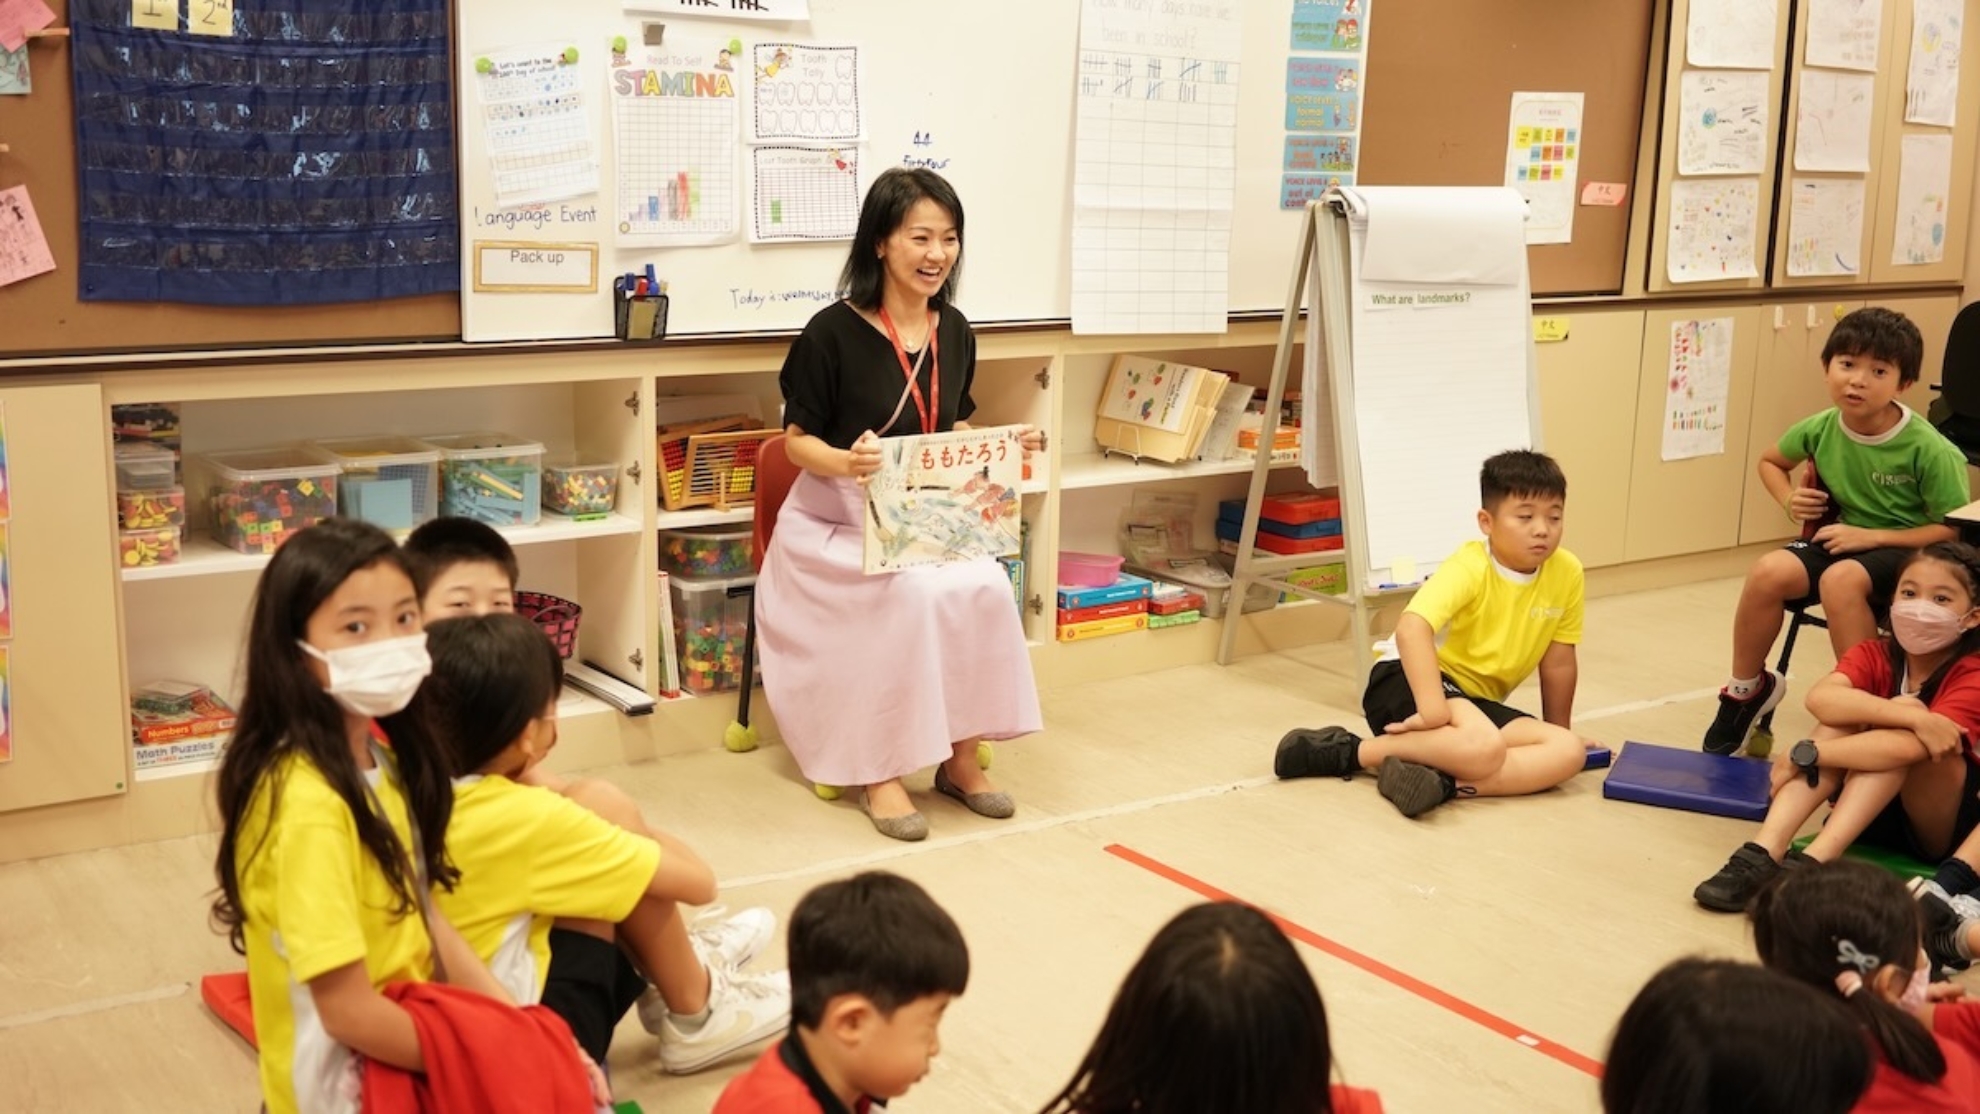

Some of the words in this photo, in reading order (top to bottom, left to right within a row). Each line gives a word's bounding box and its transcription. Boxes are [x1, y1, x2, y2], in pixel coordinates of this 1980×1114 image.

[613, 69, 735, 98] STAMINA
[560, 205, 597, 223] Event
[510, 249, 544, 263] Pack
[547, 253, 565, 266] up
[1371, 294, 1397, 305] What
[1398, 295, 1414, 305] are
[1416, 291, 1472, 304] landmarks?
[920, 438, 1007, 471] ももたろう
[148, 725, 190, 738] Numbers
[136, 748, 168, 760] Math
[171, 742, 215, 755] Puzzles
